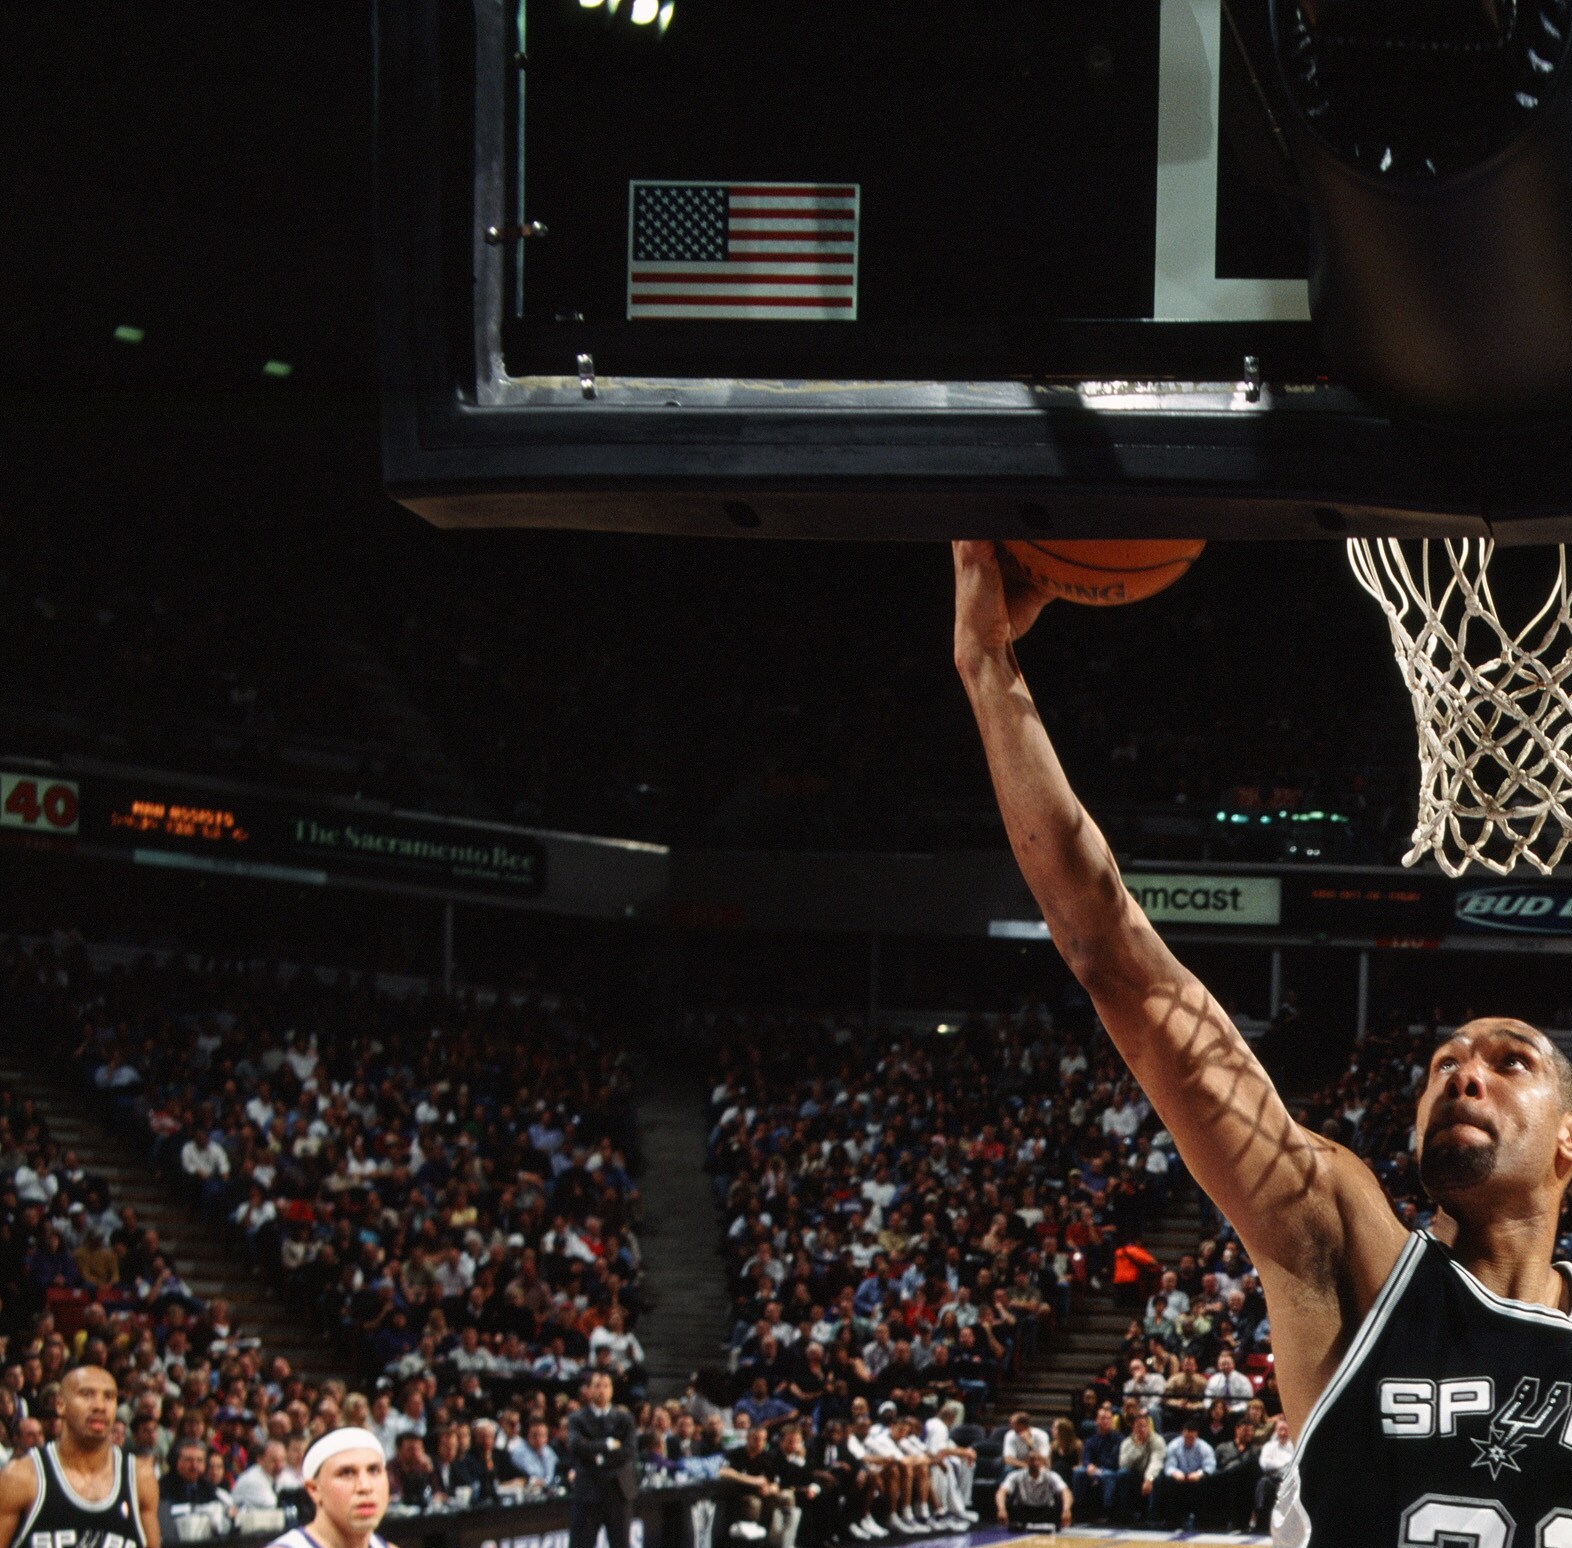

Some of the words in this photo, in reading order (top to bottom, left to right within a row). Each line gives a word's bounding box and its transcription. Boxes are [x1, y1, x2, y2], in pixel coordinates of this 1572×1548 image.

[5, 780, 79, 828] 40
[345, 825, 490, 865] Sacramento
[1128, 885, 1243, 912] omcast
[1463, 895, 1554, 917] BUD
